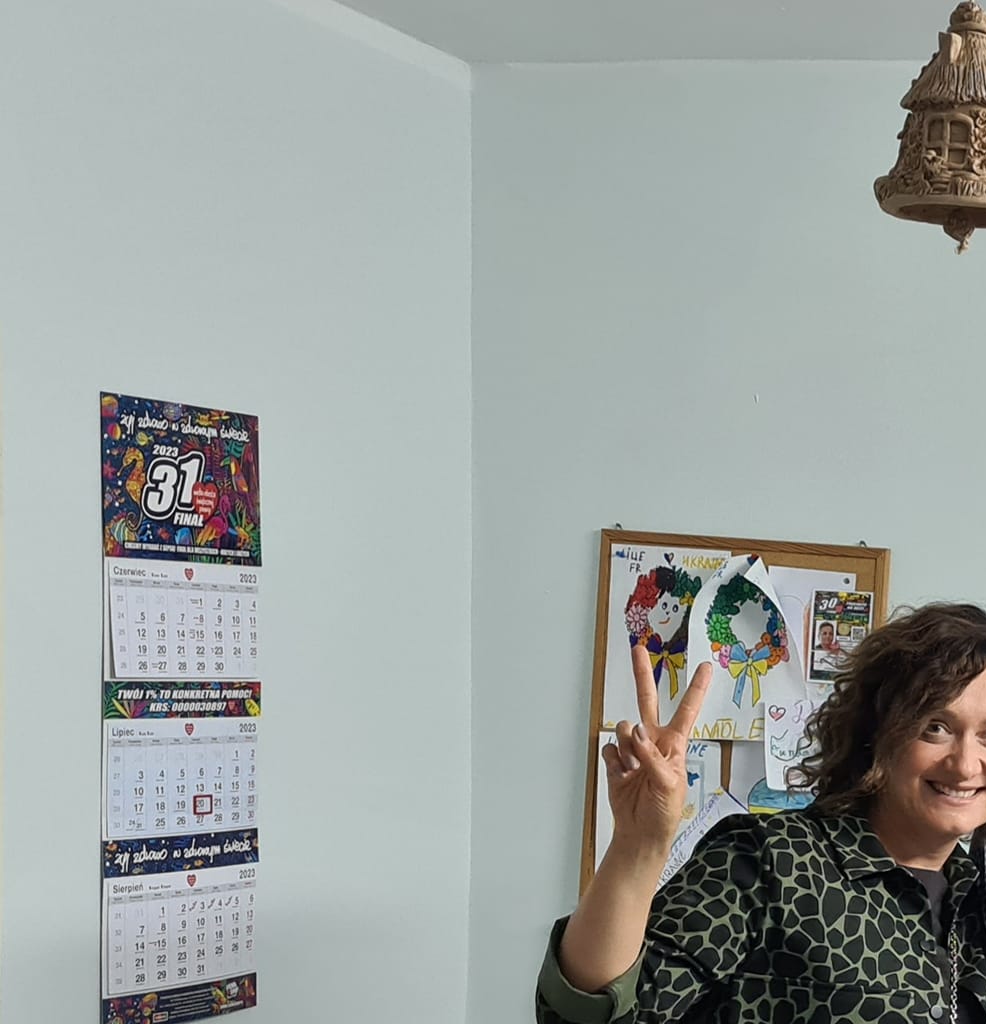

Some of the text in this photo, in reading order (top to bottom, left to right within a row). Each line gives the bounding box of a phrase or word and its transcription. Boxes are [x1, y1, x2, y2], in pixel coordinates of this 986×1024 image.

[152, 444, 179, 457] 2023
[144, 453, 204, 518] 31
[113, 565, 146, 576] Czerwiec
[239, 573, 257, 584] 2023
[819, 597, 838, 610] 30
[232, 616, 240, 624] 10
[250, 617, 256, 625] 11
[137, 629, 146, 637] 12
[157, 629, 166, 637] 13
[177, 630, 185, 638] 14
[196, 630, 205, 639] 15
[214, 631, 222, 639] 16
[233, 631, 240, 640] 17
[138, 645, 147, 654] 19
[157, 646, 166, 654] 20
[177, 646, 185, 654] 21
[196, 646, 205, 655] 22
[214, 647, 223, 655] 23
[138, 661, 224, 671] 26 27 28 29 30
[118, 688, 143, 700] TWÓJ
[160, 689, 170, 699] TO
[171, 689, 220, 700] KONKRETNA
[149, 702, 226, 712] KRS: 0000030897
[112, 727, 134, 737] Lipiec
[239, 723, 257, 733] 2023
[134, 787, 144, 796] 10
[156, 786, 164, 794] 11
[176, 785, 185, 793] 12
[196, 784, 204, 792] 13
[214, 783, 222, 791] 14
[134, 803, 144, 812] 17
[156, 802, 165, 811] 18
[177, 801, 185, 809] 19
[155, 818, 165, 827] 25
[113, 883, 144, 894] Sierpień
[239, 869, 256, 880] 2023
[197, 918, 205, 926] 10
[215, 915, 222, 923] 11
[232, 913, 239, 921] 12
[135, 942, 145, 951] 14
[158, 939, 166, 948] 15
[178, 936, 187, 945] 16
[197, 934, 205, 942] 17
[135, 958, 144, 967] 21
[157, 955, 166, 964] 22
[178, 952, 187, 960] 23
[197, 949, 205, 957] 24
[135, 965, 204, 983] 28 29 30 31
